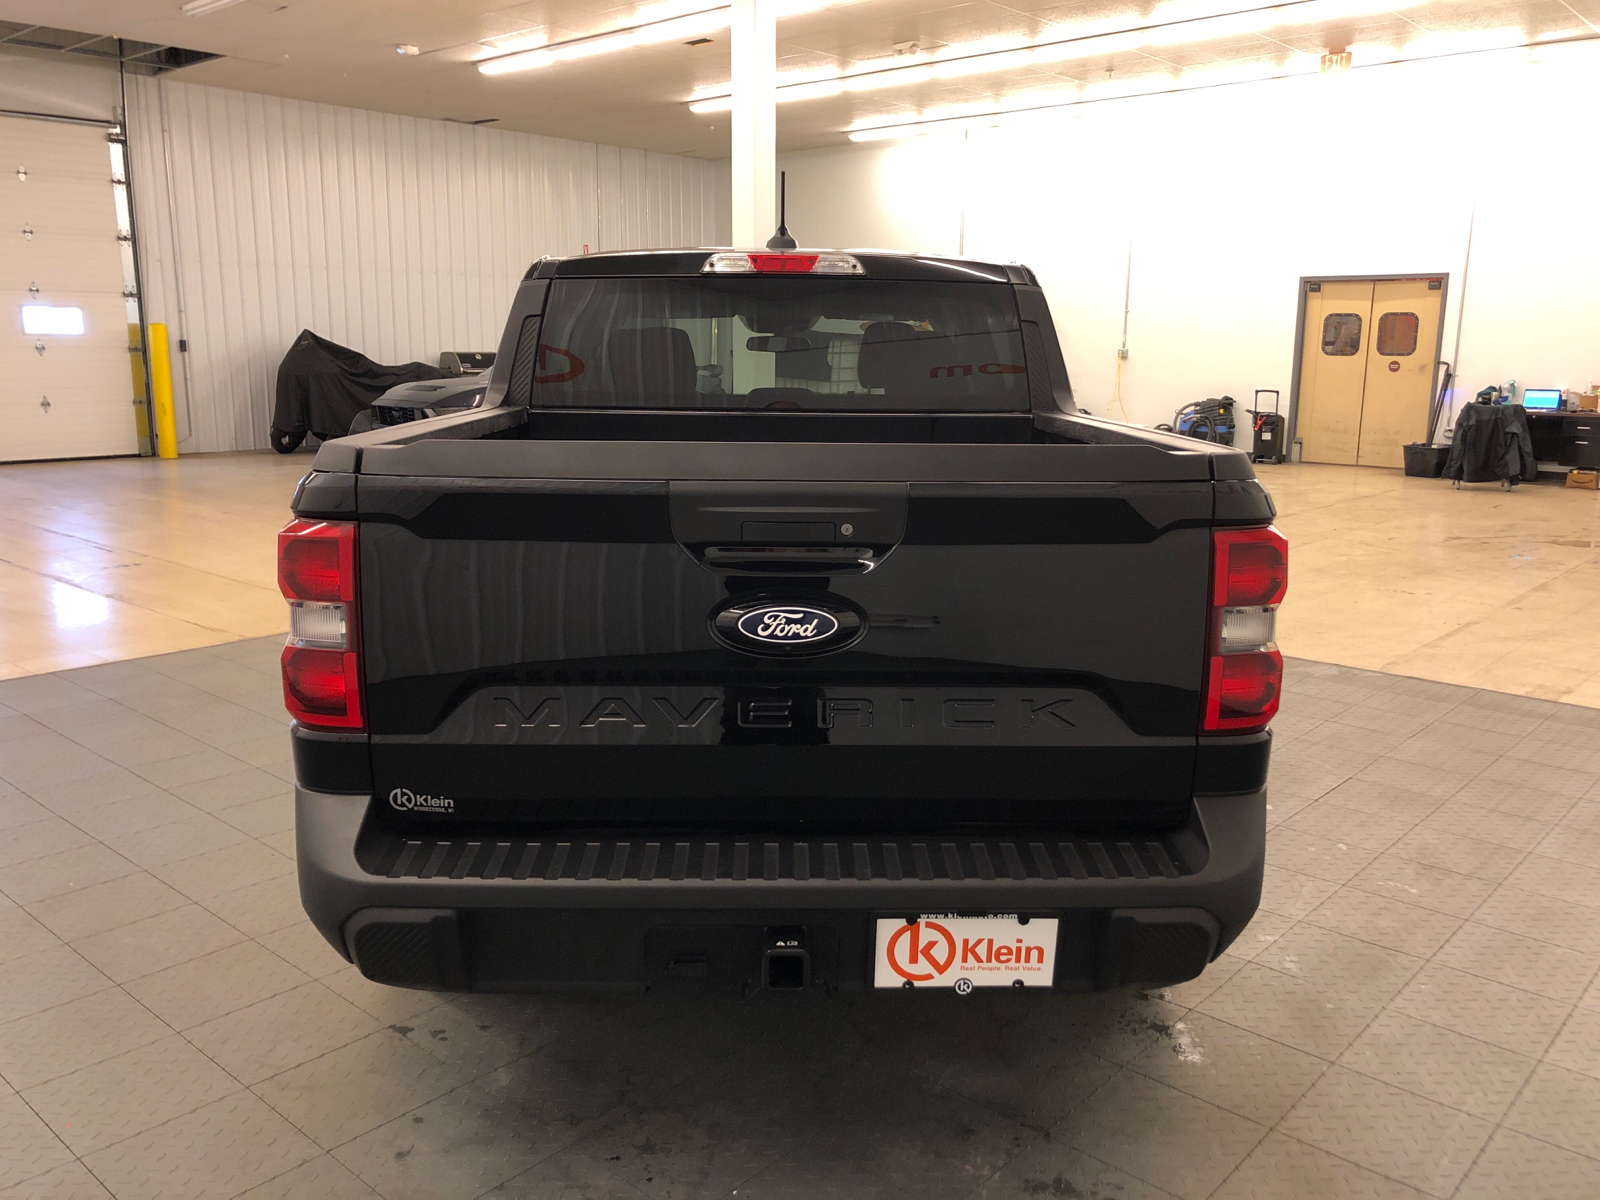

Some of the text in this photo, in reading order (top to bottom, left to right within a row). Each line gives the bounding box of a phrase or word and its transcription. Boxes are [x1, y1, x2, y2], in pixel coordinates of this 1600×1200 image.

[757, 612, 819, 637] Ford
[493, 696, 1077, 729] MAVERICK
[416, 794, 454, 808] Klein
[960, 938, 1045, 964] Klein
